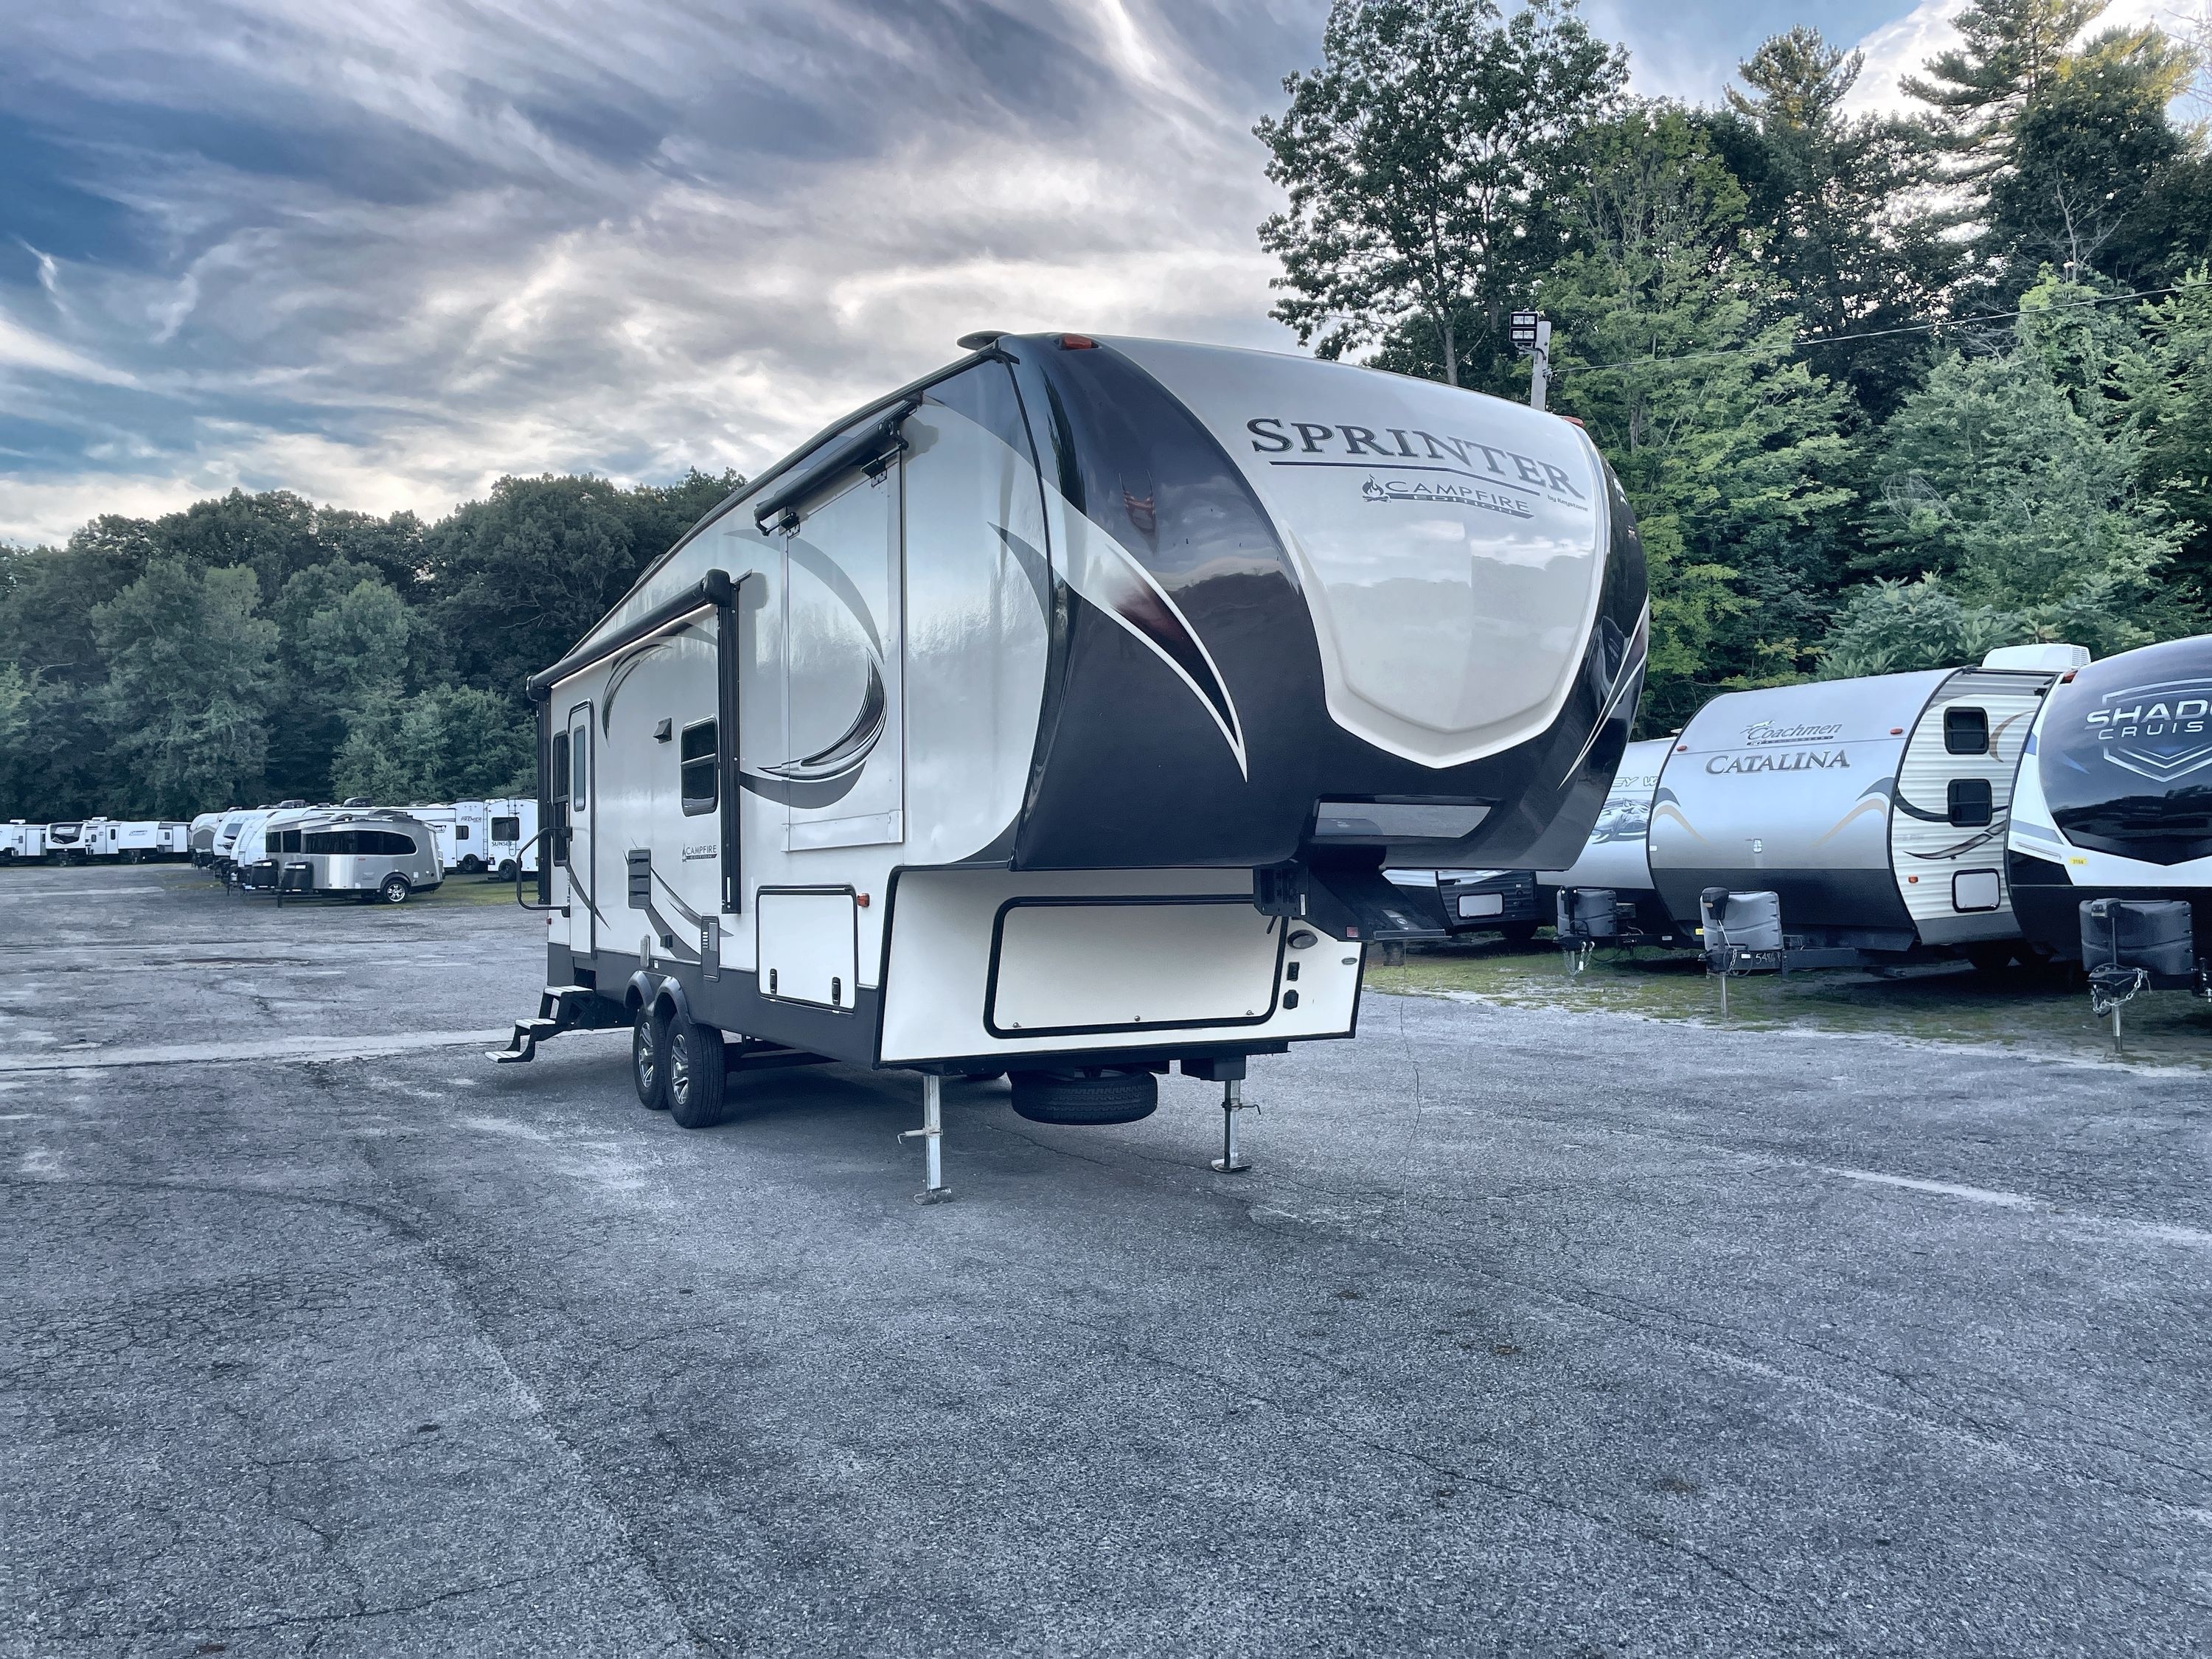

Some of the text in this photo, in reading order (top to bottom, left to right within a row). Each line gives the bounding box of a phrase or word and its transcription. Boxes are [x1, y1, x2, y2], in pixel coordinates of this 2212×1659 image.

[1247, 417, 1586, 501] SPRINTER
[1385, 481, 1531, 514] CAMPFIRE
[1412, 495, 1513, 515] EDITION
[1557, 498, 1588, 512] Keystone
[2084, 699, 2212, 730] SHAD
[1747, 723, 1843, 740] Coachmen
[1705, 749, 1851, 775] CATALINA
[686, 845, 717, 855] CAMPFIRE
